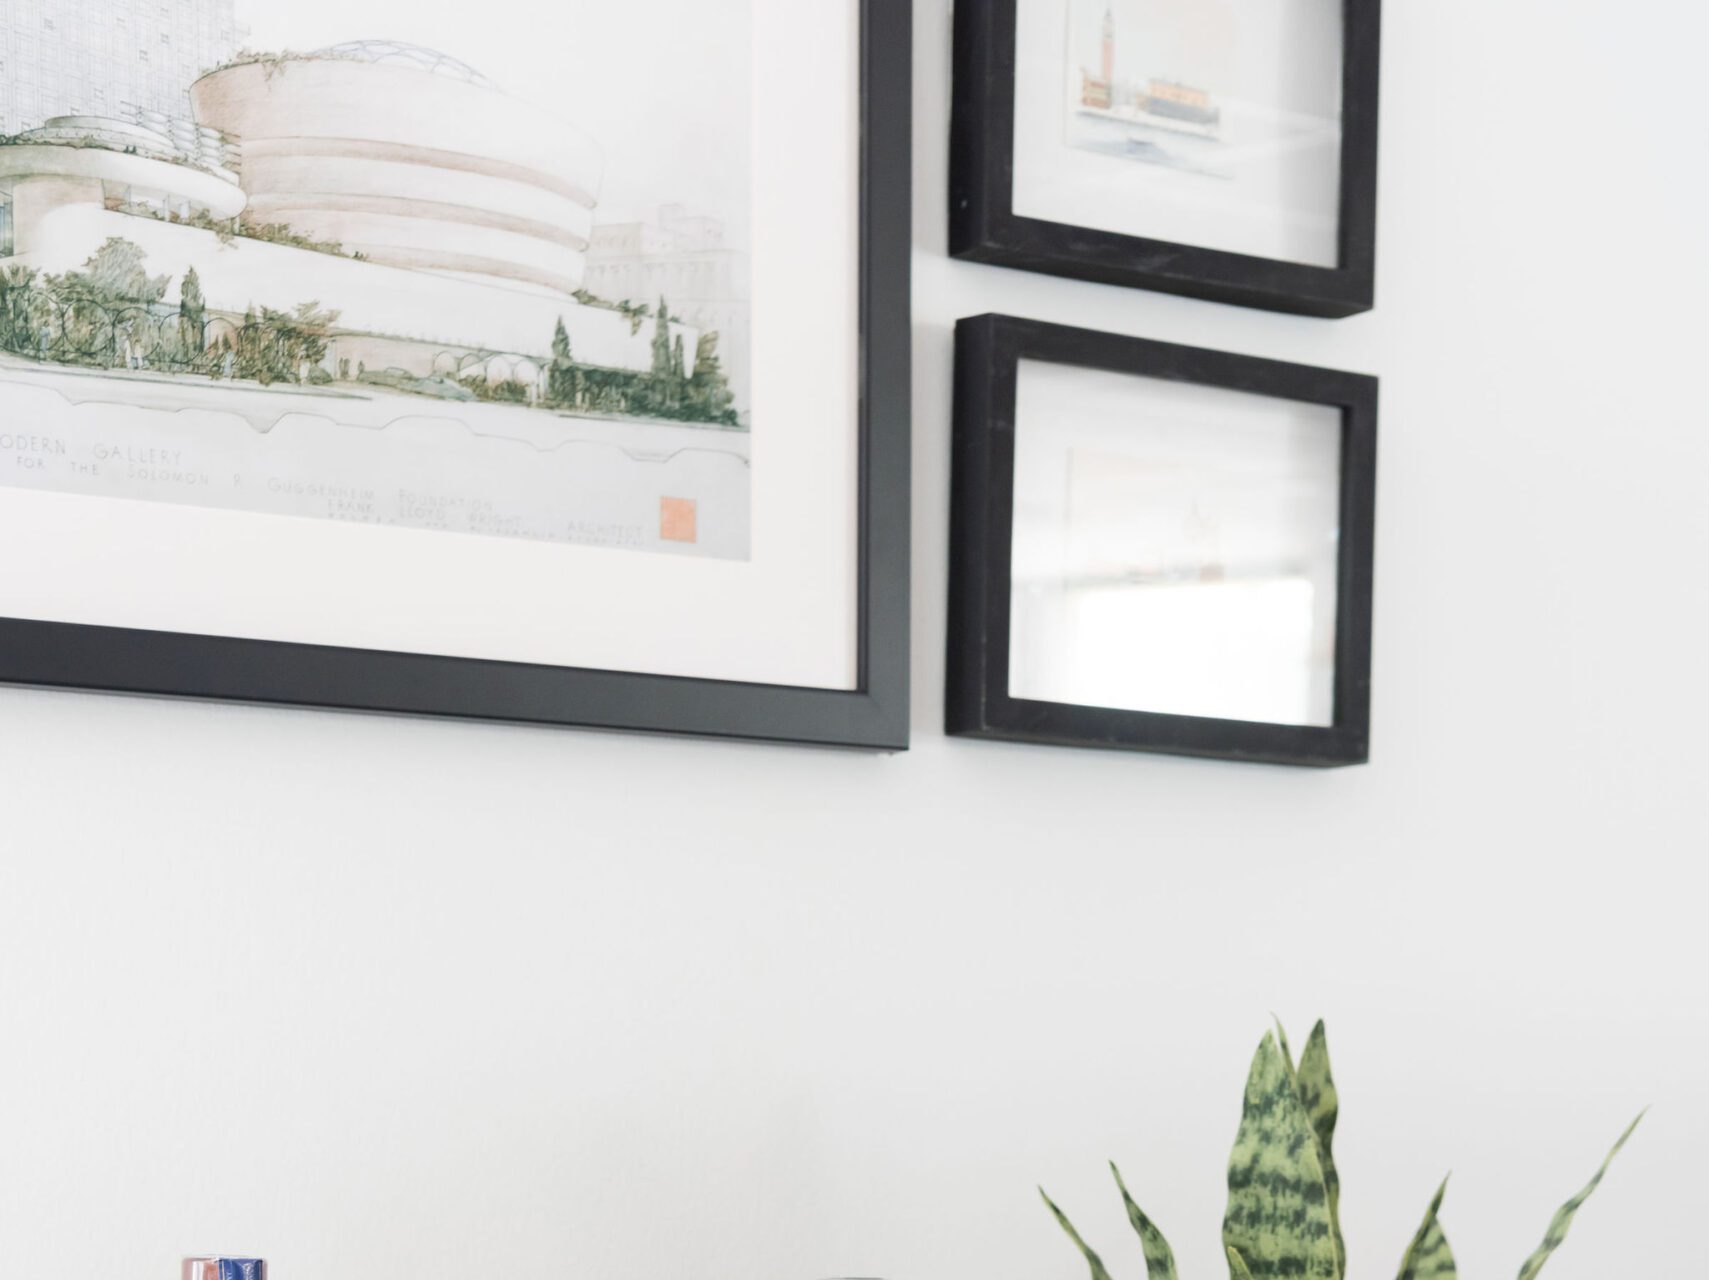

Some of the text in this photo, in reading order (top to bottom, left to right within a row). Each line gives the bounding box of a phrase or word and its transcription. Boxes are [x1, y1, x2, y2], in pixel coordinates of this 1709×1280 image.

[0, 433, 182, 466] ODERN GALLERY
[16, 455, 46, 471] FOR
[70, 460, 100, 477] THE
[126, 463, 209, 487] SOLOMON
